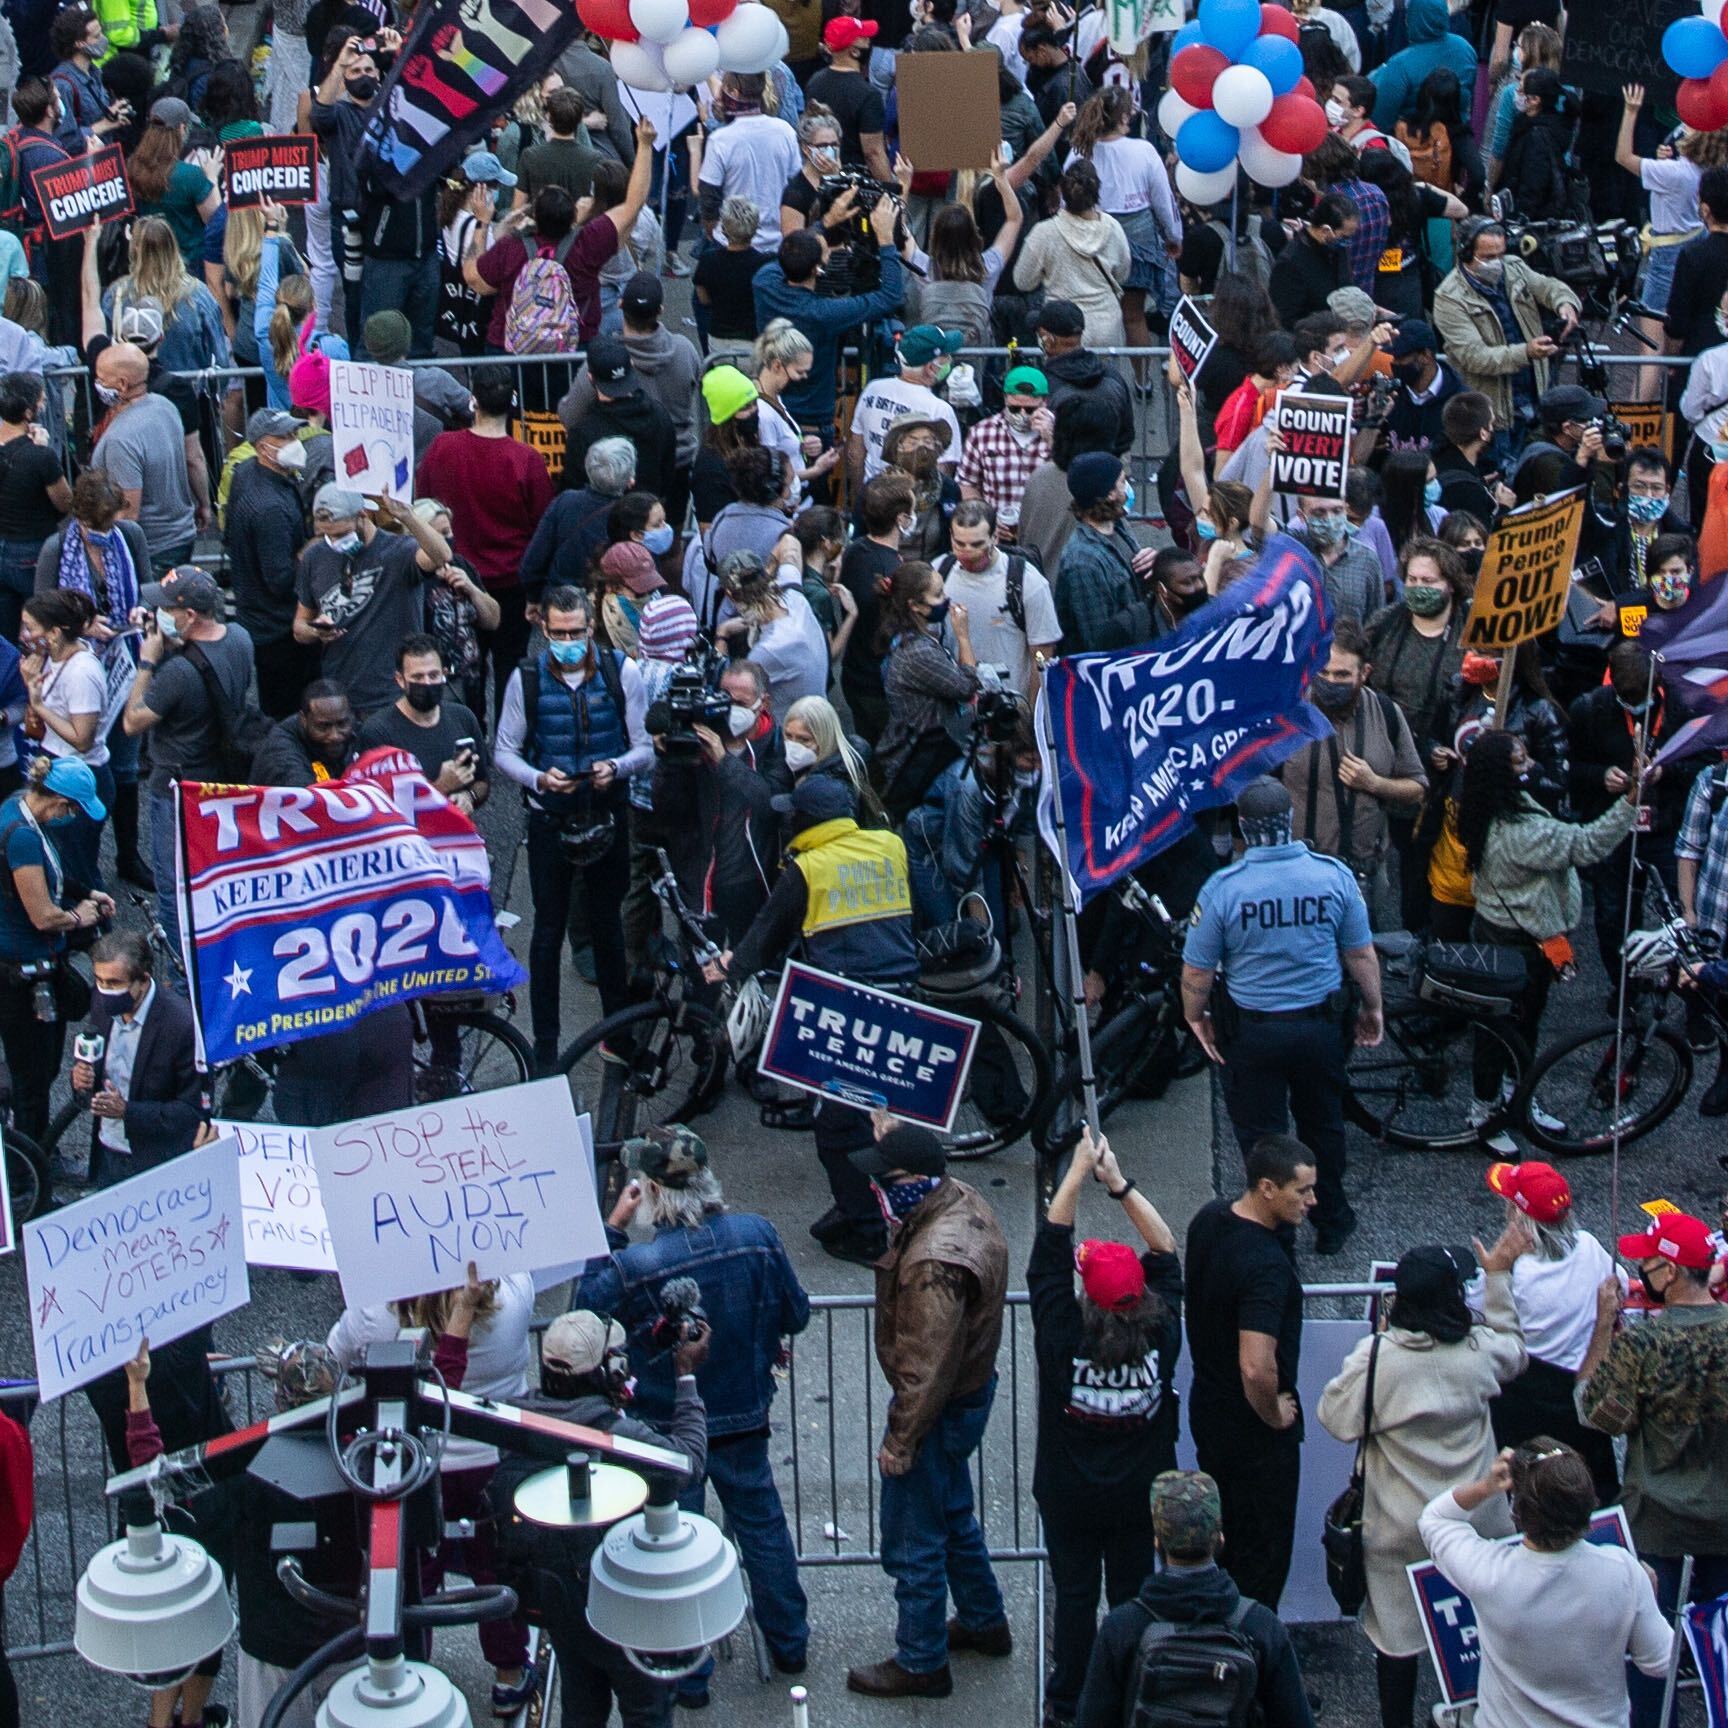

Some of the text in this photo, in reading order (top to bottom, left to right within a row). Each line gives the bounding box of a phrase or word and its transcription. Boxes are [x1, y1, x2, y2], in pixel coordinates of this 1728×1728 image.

[231, 146, 308, 170] TRUMP MUST
[232, 166, 311, 195] CONCEDE
[43, 171, 89, 200] TRUMP
[49, 177, 128, 223] CONCEDE
[1171, 312, 1207, 360] COUNT
[333, 365, 379, 396] FLIP
[1280, 407, 1345, 434] COUNT
[1283, 432, 1343, 458] EVERY
[1277, 456, 1341, 488] VOTE
[1496, 505, 1575, 552] Trump/
[1498, 538, 1566, 572] Pence
[1492, 562, 1560, 610] OUT
[1469, 594, 1562, 644] NOW!
[1624, 614, 1644, 623] OUT
[1122, 679, 1236, 766] 2020-
[213, 872, 293, 914] KEEP
[1241, 897, 1332, 931] POLICE
[271, 967, 469, 1037] PRESIDENT UNITED
[789, 996, 958, 1066] TRUMP
[797, 1022, 937, 1085] PENCE
[807, 1048, 878, 1077] KEEP AMERICA
[334, 1107, 516, 1175] STOP the
[414, 1144, 526, 1187] STEAL
[36, 1175, 214, 1270] Democracy
[373, 1170, 557, 1249] AUDIT
[101, 1223, 179, 1268] means
[430, 1217, 529, 1274] NOW
[76, 1235, 207, 1317] VOTERS
